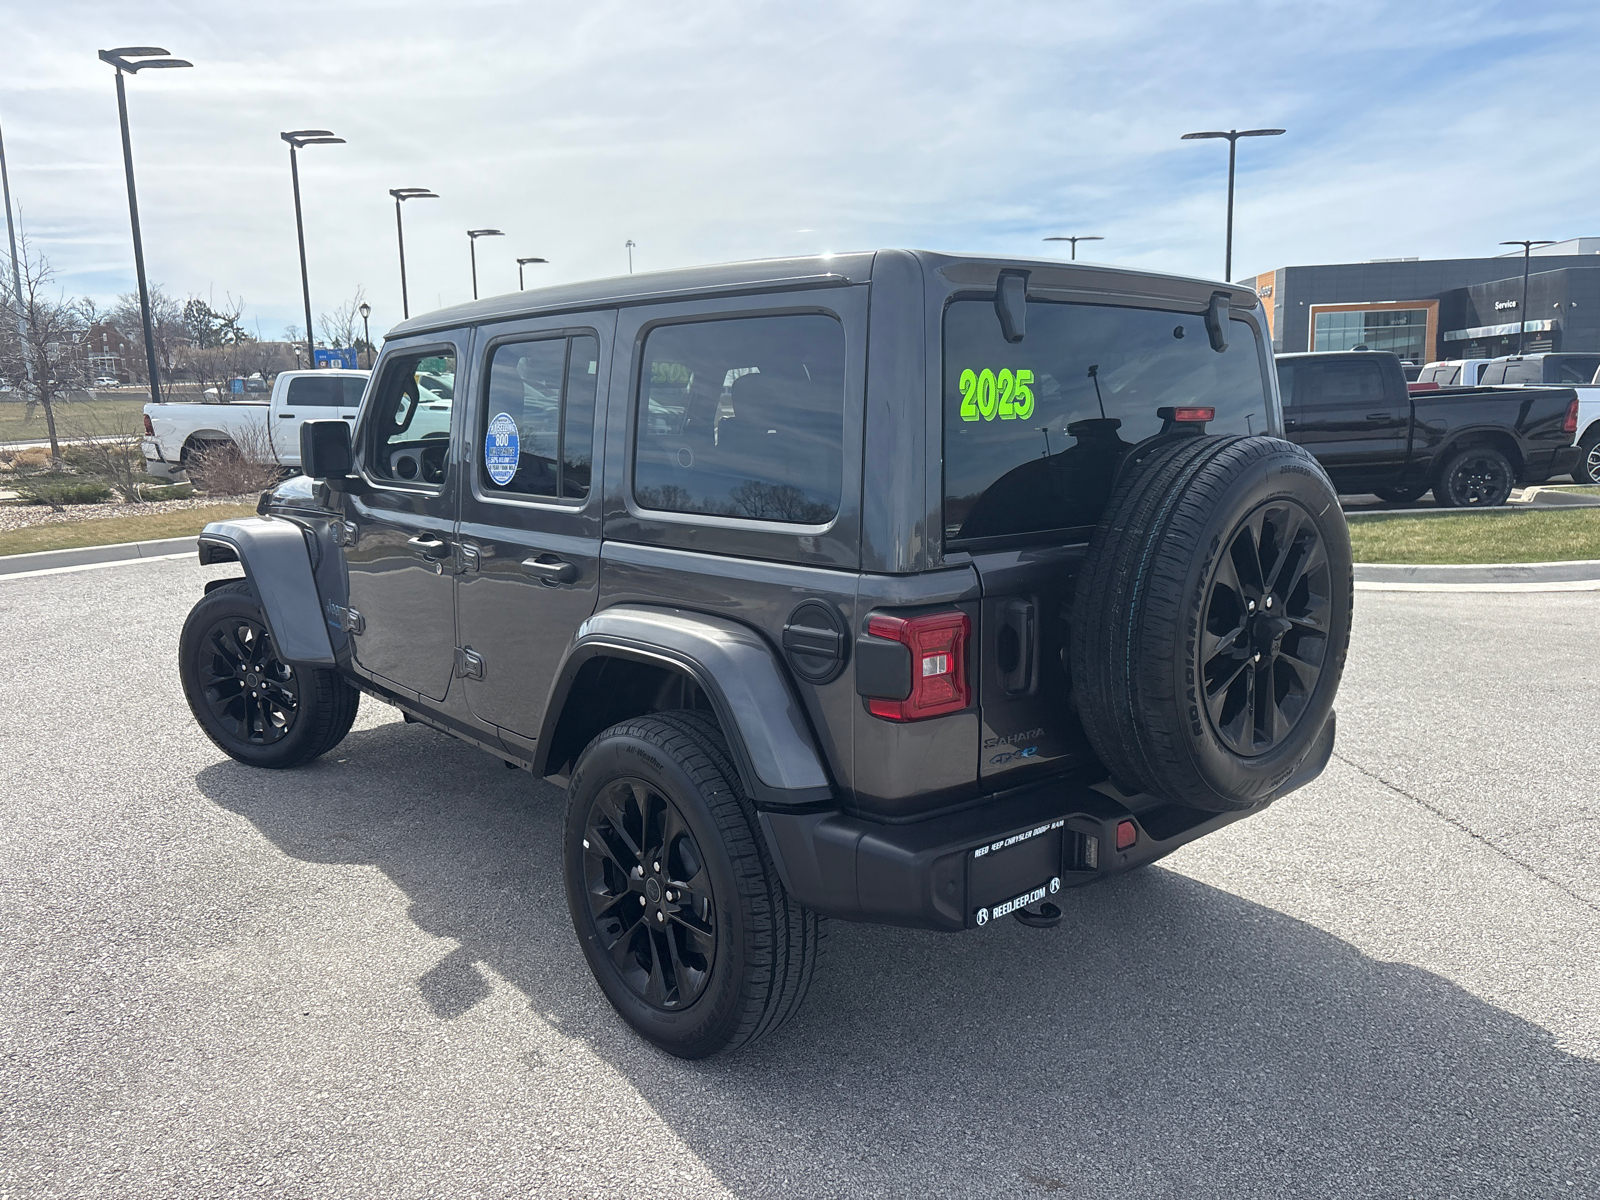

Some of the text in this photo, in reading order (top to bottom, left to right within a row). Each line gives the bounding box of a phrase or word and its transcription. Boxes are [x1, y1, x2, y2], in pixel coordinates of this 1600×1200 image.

[1494, 300, 1517, 310] Service
[959, 367, 1035, 422] 2025
[496, 434, 509, 447] 800
[1184, 616, 1204, 737] ROADIAN
[983, 727, 1045, 749] SAHARA
[625, 745, 665, 770] All-Weather
[974, 845, 990, 859] REED
[1004, 829, 1033, 847] CHRYSLER
[1050, 819, 1065, 830] RAM
[992, 886, 1046, 920] REEDJEEP.COM
